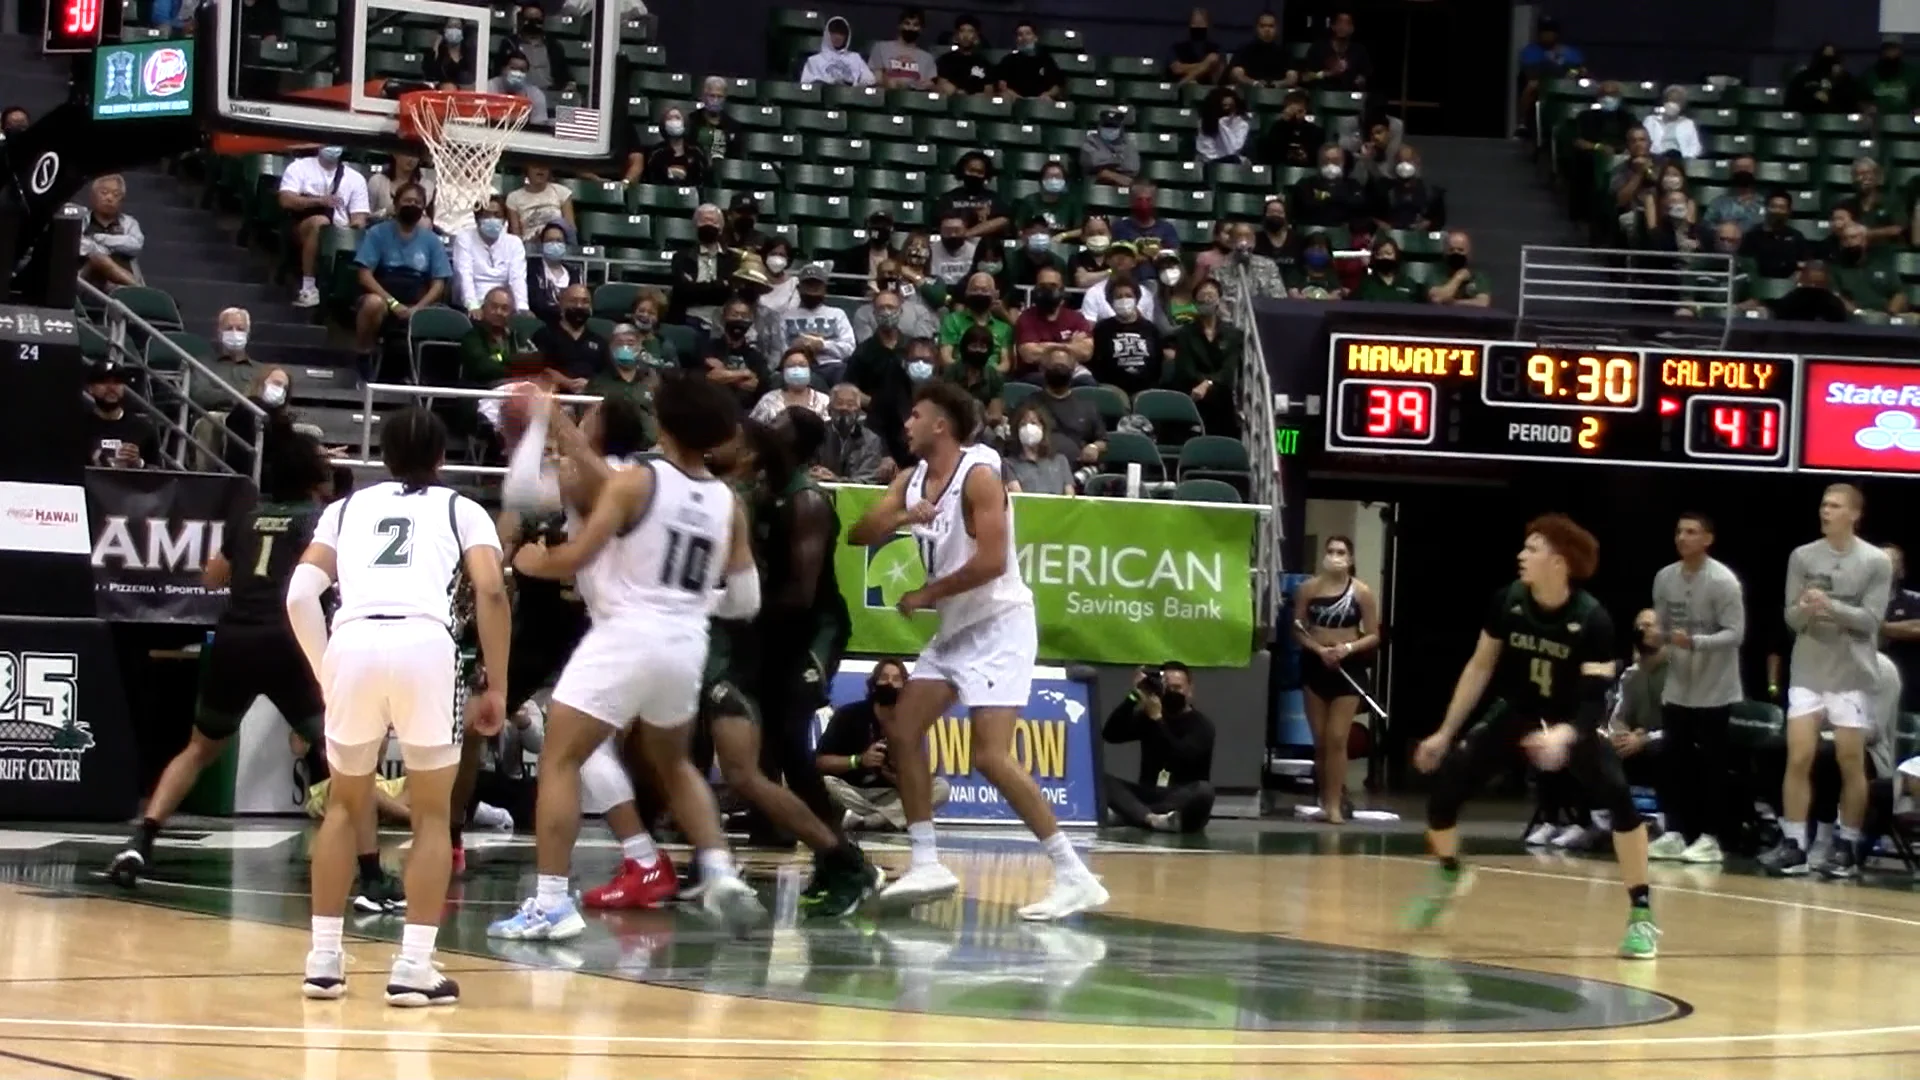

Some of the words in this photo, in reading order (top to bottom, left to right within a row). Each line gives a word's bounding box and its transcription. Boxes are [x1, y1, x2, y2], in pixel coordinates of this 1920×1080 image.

[20, 343, 39, 361] 24
[1527, 354, 1632, 404] 9:30
[1825, 381, 1898, 406] State
[1368, 388, 1425, 433] 39
[1508, 422, 1572, 443] PERIOD
[1578, 416, 1599, 449] 2
[1714, 407, 1775, 449] 41
[35, 508, 79, 524] HAWAII
[253, 534, 275, 577] 1
[367, 517, 415, 569] 2
[661, 527, 714, 595] 10
[1066, 591, 1154, 622] Savings
[1164, 596, 1222, 619] Bank
[1530, 657, 1552, 697] 4
[29, 758, 81, 781] CENTER
[978, 785, 998, 803] ON
